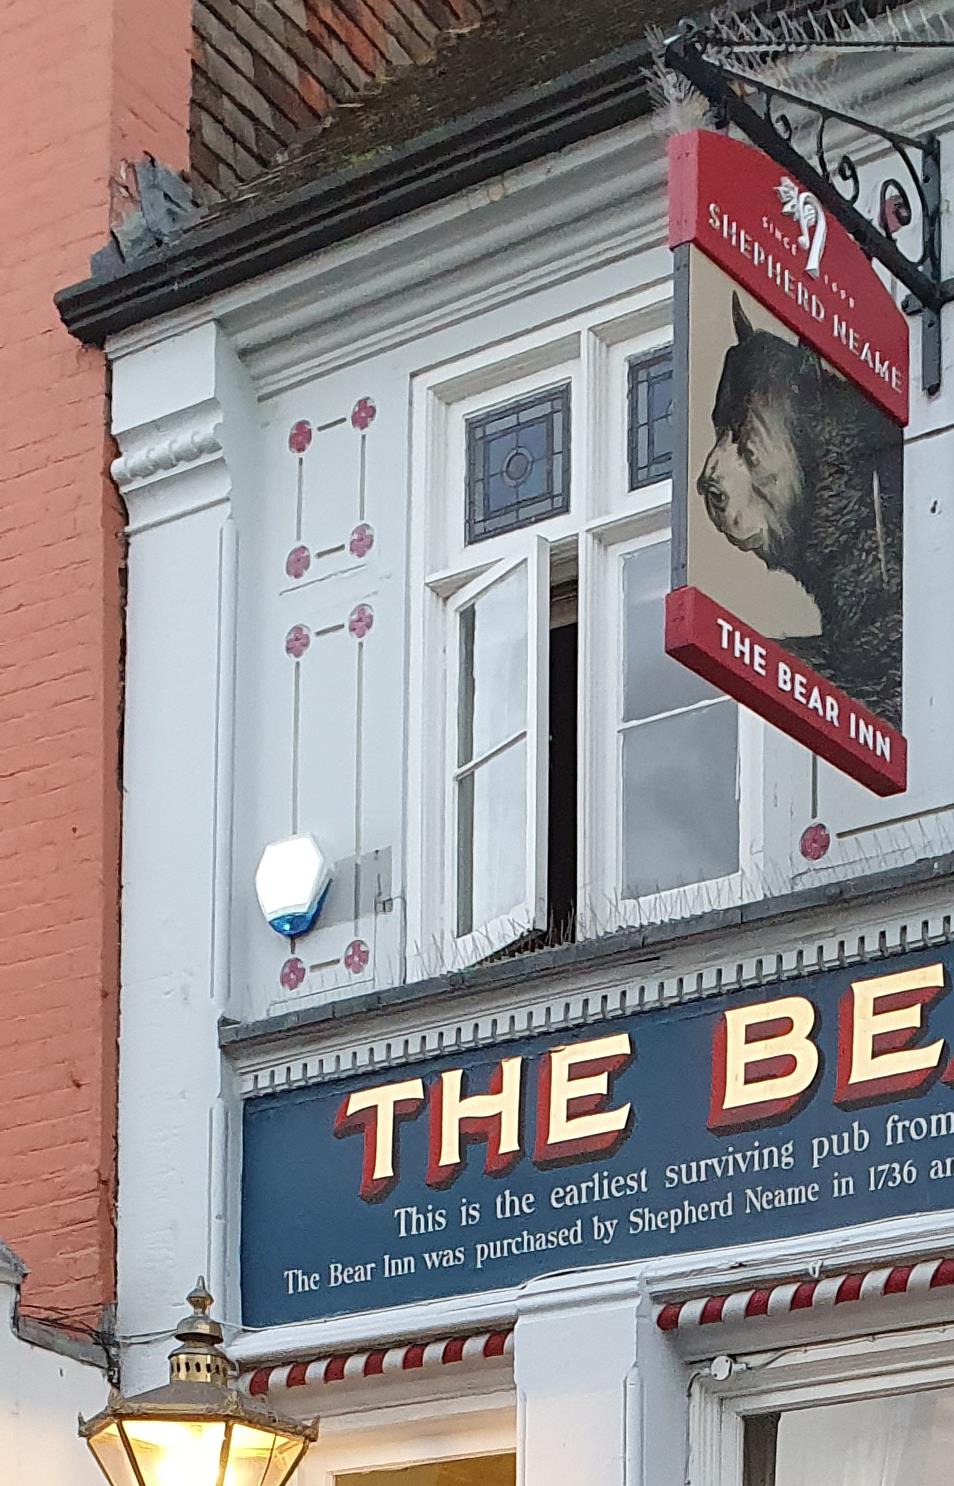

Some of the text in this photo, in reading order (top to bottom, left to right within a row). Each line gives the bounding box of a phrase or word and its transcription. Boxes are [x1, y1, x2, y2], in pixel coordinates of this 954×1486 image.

[708, 203, 902, 394] SHEPHERD NEAME
[717, 618, 892, 763] THE BEAR INN
[335, 1033, 634, 1200] THE
[394, 1204, 447, 1238] This
[460, 1196, 480, 1227] is
[495, 1188, 535, 1219] the
[551, 1167, 648, 1209] earliest
[665, 1136, 795, 1188] surviving
[811, 1123, 870, 1168] pub
[285, 1265, 320, 1296] The
[329, 1259, 377, 1289] Bear
[383, 1254, 416, 1278] Inn
[423, 1246, 465, 1270] was
[476, 1224, 583, 1269] purchased
[593, 1216, 619, 1245] by
[628, 1198, 734, 1240] Shepherd
[745, 1183, 820, 1213] Neame
[832, 1165, 855, 1197] in
[867, 1157, 918, 1192] 1736
